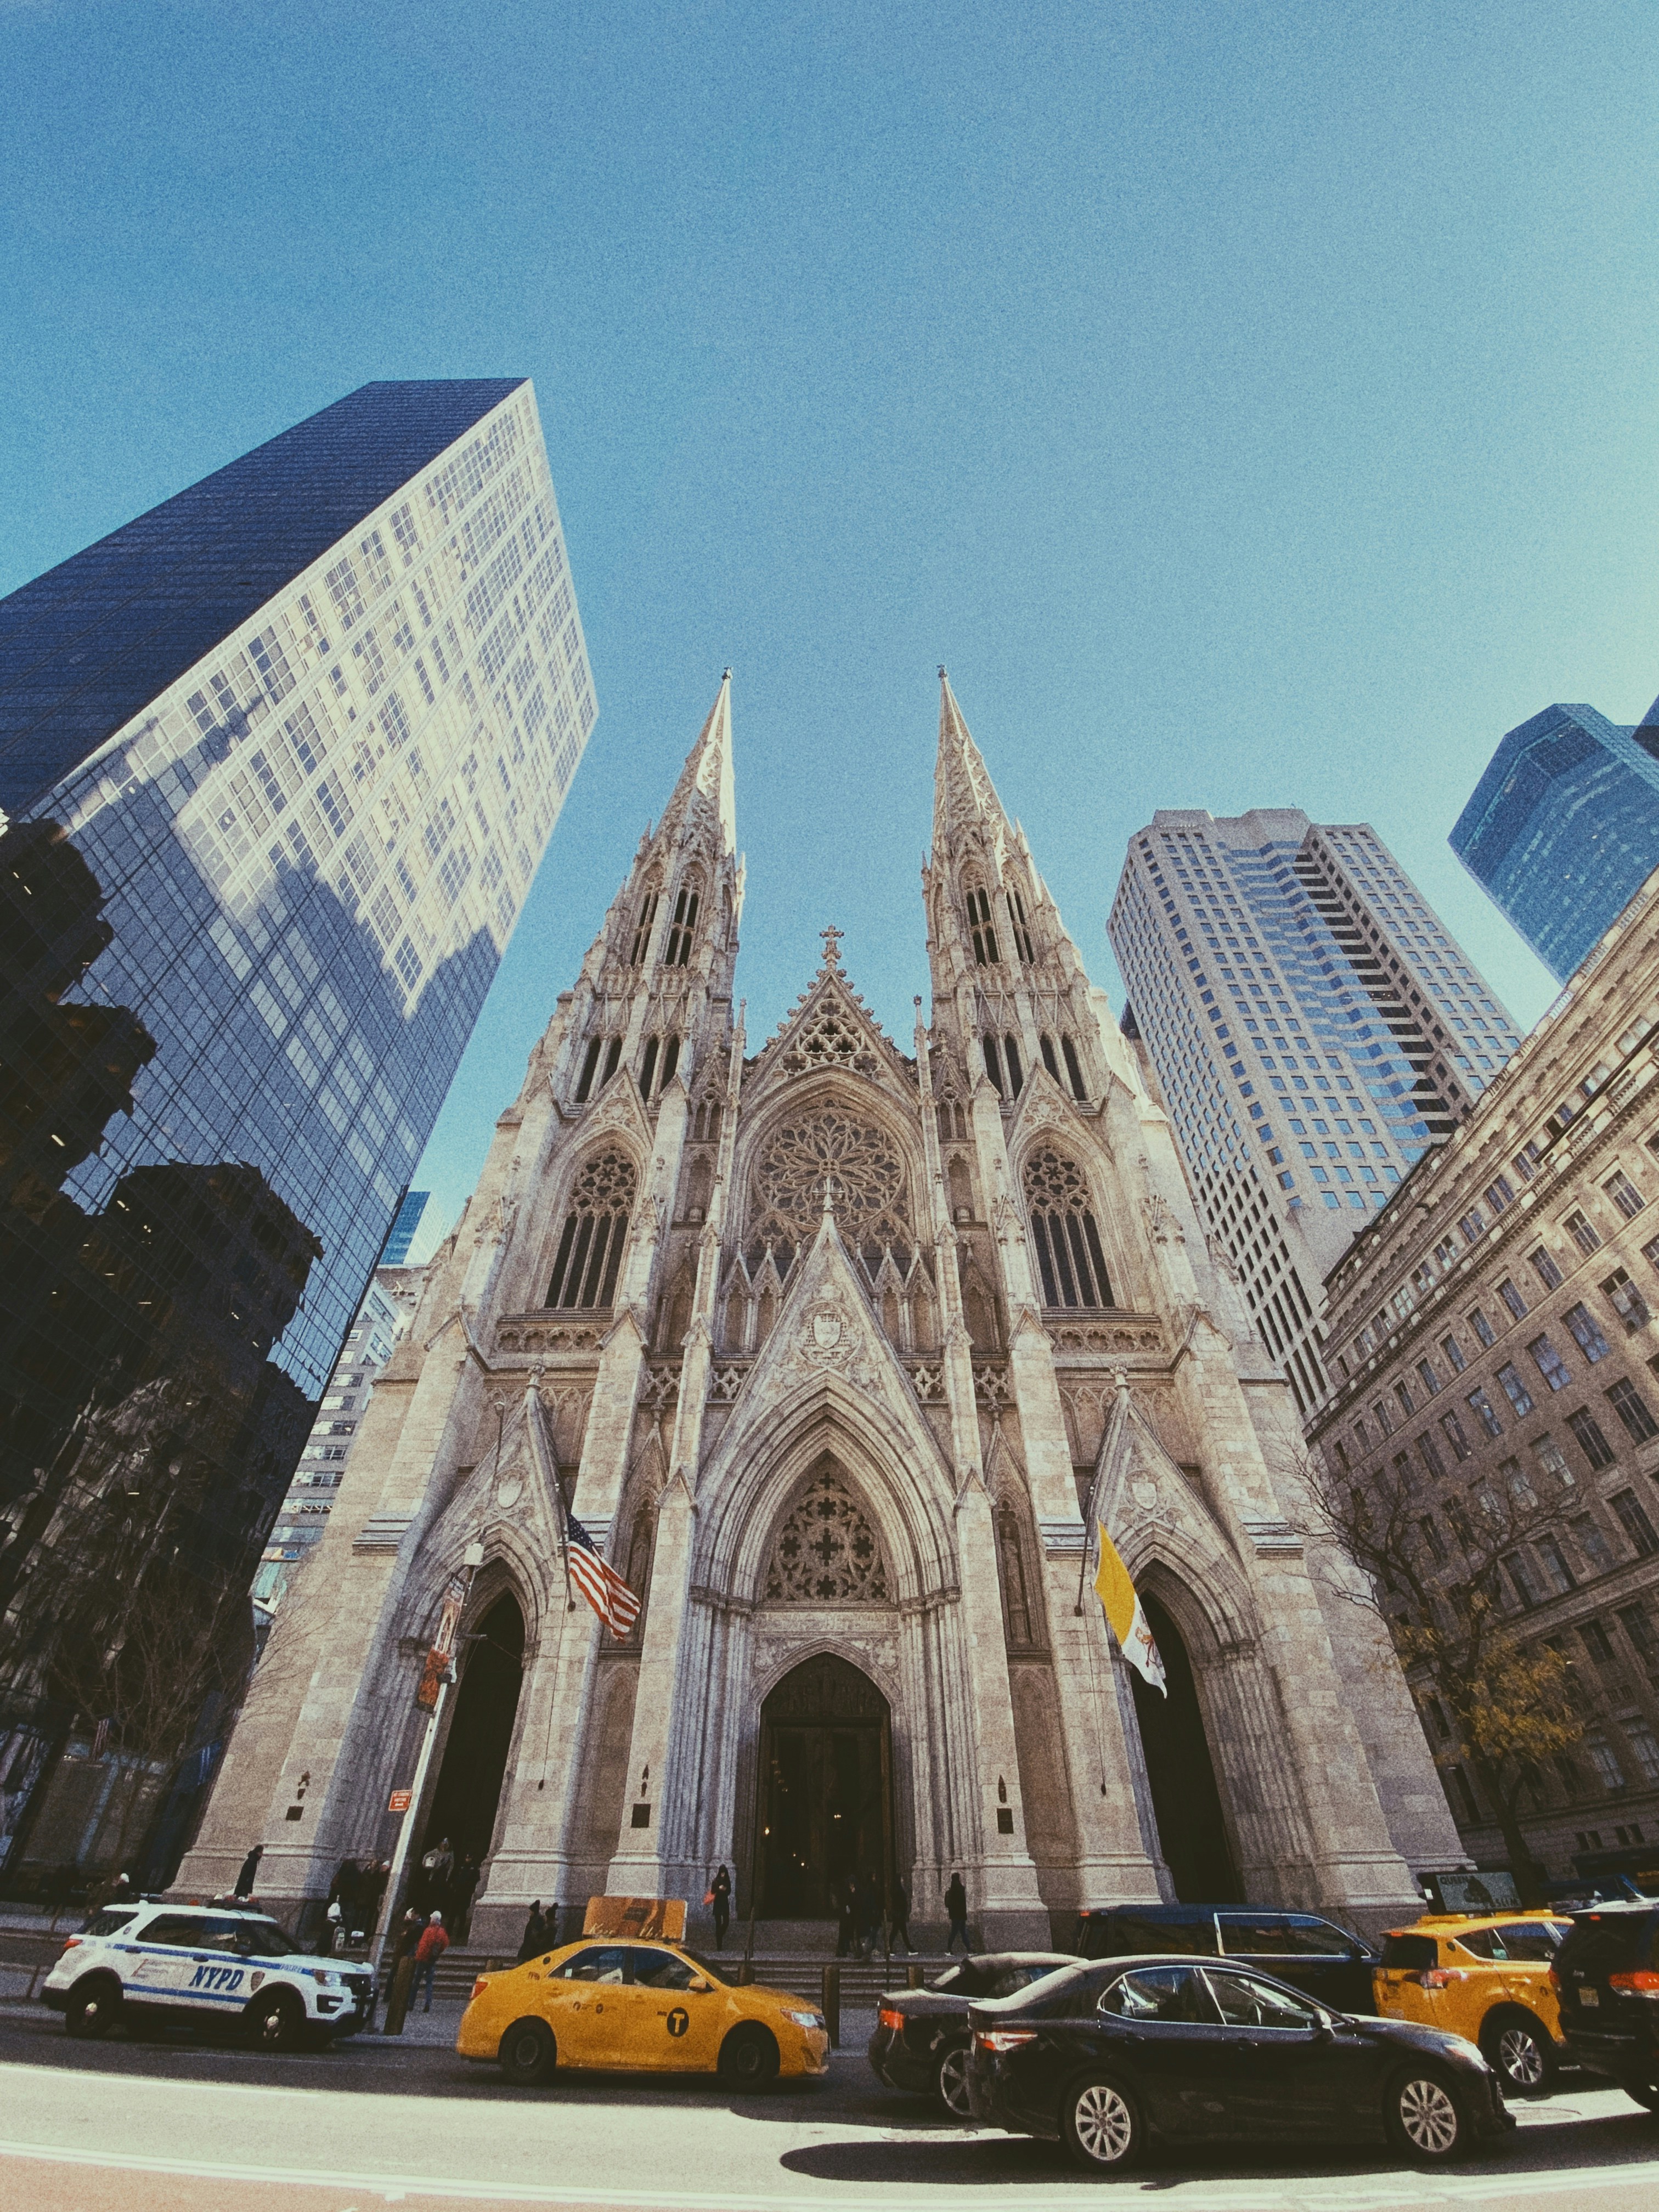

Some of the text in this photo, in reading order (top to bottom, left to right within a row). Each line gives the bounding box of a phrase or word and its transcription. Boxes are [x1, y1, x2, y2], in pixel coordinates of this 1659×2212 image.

[1440, 1876, 1470, 1885] QUEEN
[1495, 1898, 1519, 1907] SLIM
[188, 1965, 245, 1990] NYPD
[673, 2012, 685, 2034] T
